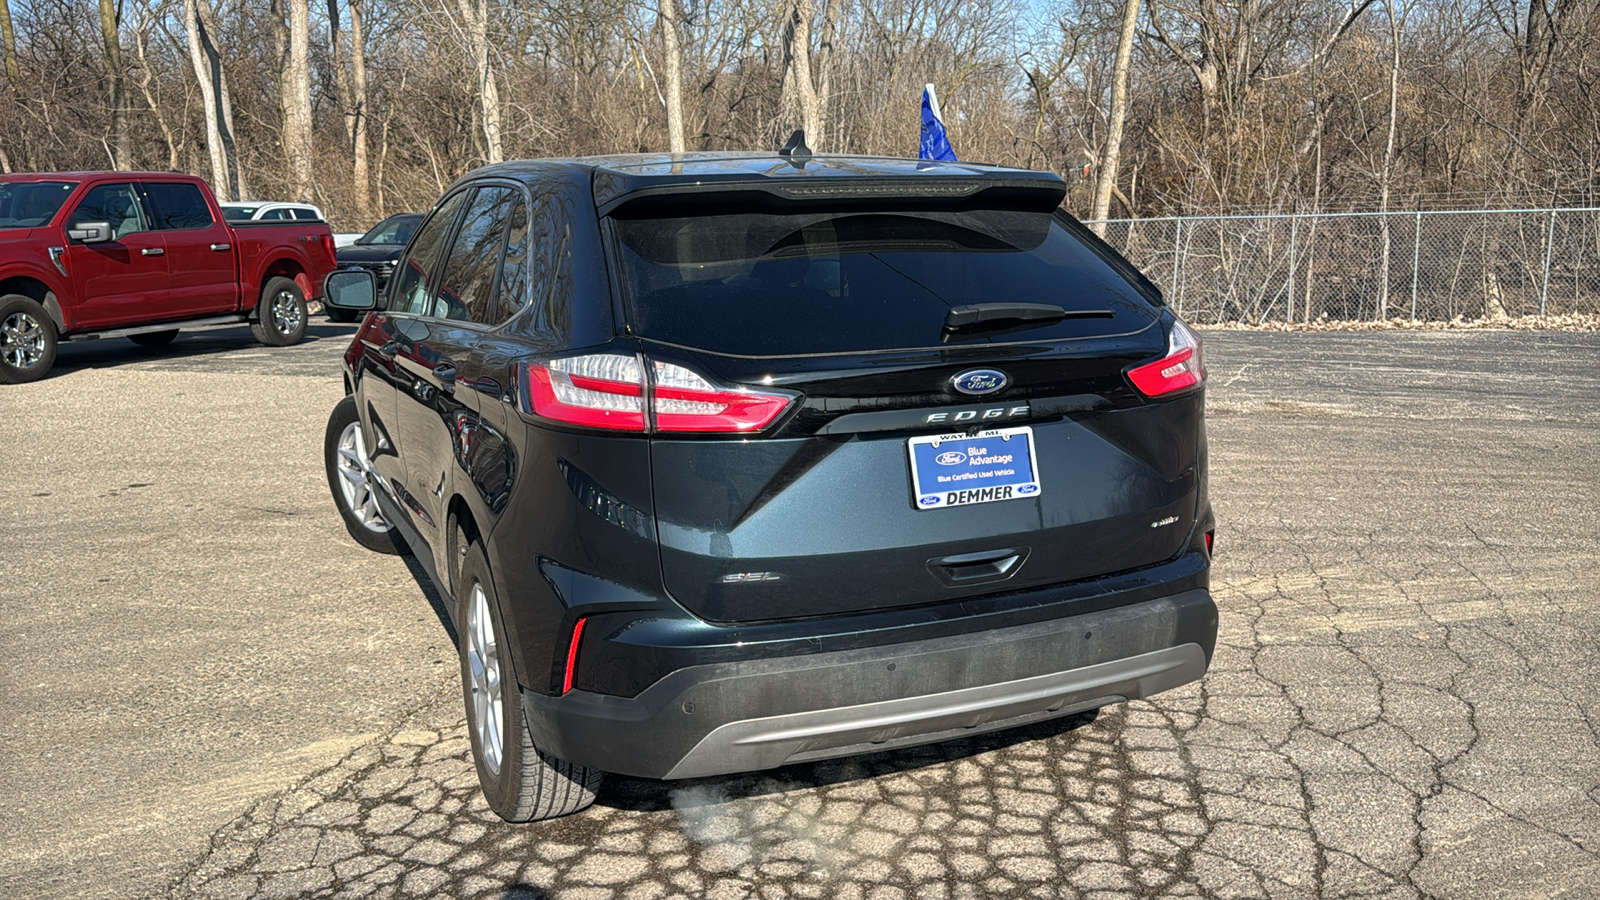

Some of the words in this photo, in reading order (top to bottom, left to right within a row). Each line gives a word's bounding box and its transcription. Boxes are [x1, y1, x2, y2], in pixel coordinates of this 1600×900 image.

[926, 406, 1030, 423] EDGE
[968, 446, 987, 456] Blue
[969, 454, 1013, 466] Advantage
[937, 475, 951, 483] Blue
[952, 472, 977, 481] Certified
[978, 470, 993, 478] Used
[994, 468, 1015, 477] Vehicle
[946, 486, 1013, 505] DEMMER
[722, 572, 781, 584] SEL
